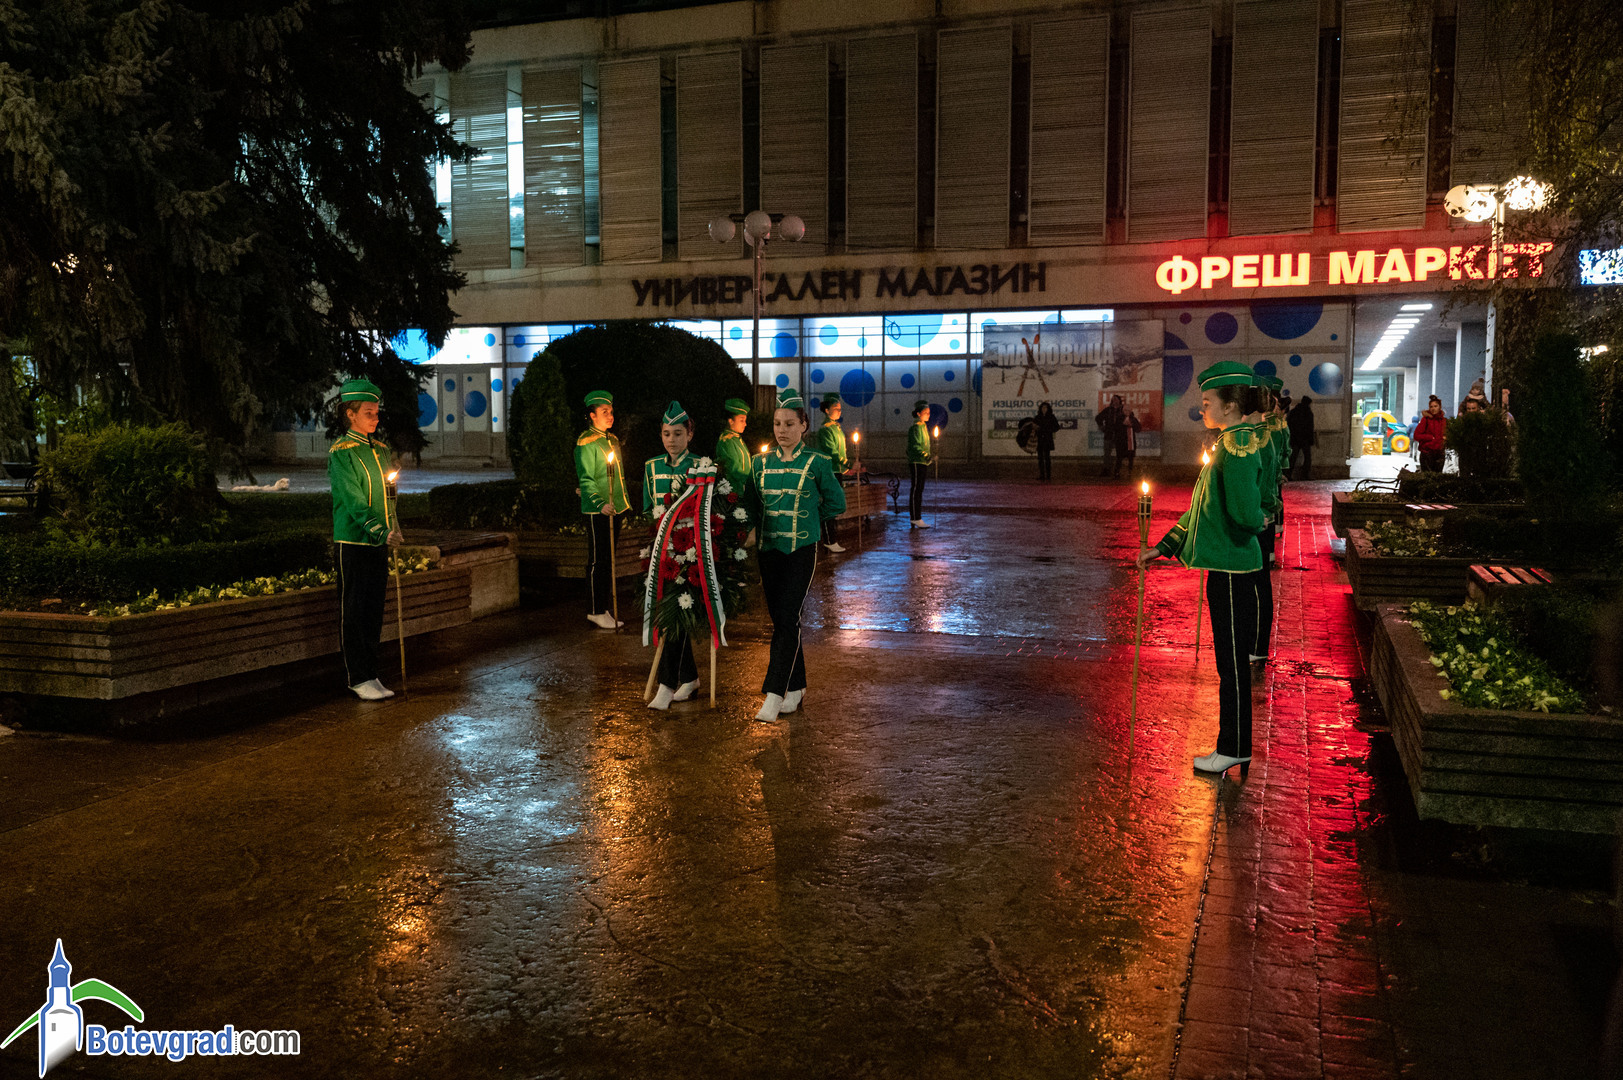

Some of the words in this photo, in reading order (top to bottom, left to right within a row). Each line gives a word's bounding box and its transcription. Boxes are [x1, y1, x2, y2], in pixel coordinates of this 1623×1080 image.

[632, 269, 862, 307] УНИВЕРСАЛЕН
[876, 262, 1046, 299] МАГАЗИН
[1155, 252, 1311, 294] ФРЕШ
[1328, 242, 1554, 285] МАРКЕТ
[993, 400, 1034, 408] ИЗЦЯЛО
[1036, 400, 1086, 408] ОНОВЕН
